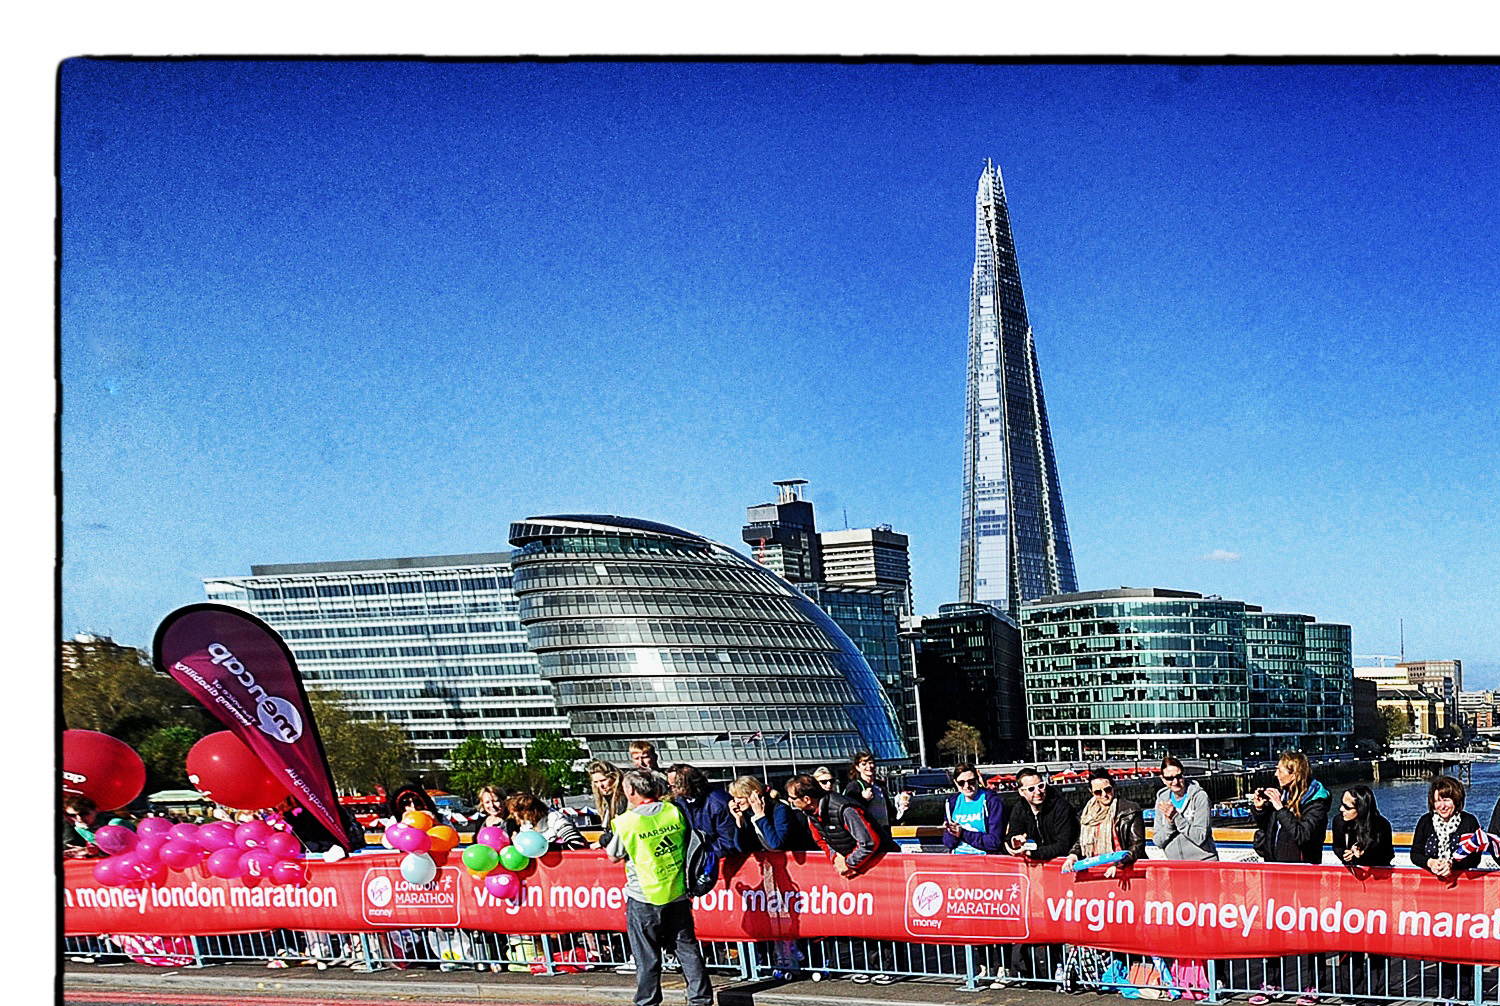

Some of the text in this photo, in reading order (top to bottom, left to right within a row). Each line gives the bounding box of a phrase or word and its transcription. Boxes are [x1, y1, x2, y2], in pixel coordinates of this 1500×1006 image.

[76, 887, 148, 914] money
[152, 882, 226, 908] london
[230, 884, 338, 908] marathon
[395, 893, 454, 904] MARATHON
[742, 885, 874, 916] marathon
[947, 887, 1004, 901] LONDON
[946, 902, 1020, 916] MARATHON
[1047, 890, 1135, 932] virgin
[1145, 900, 1259, 938] money
[1266, 898, 1387, 935] london
[913, 918, 942, 929] money
